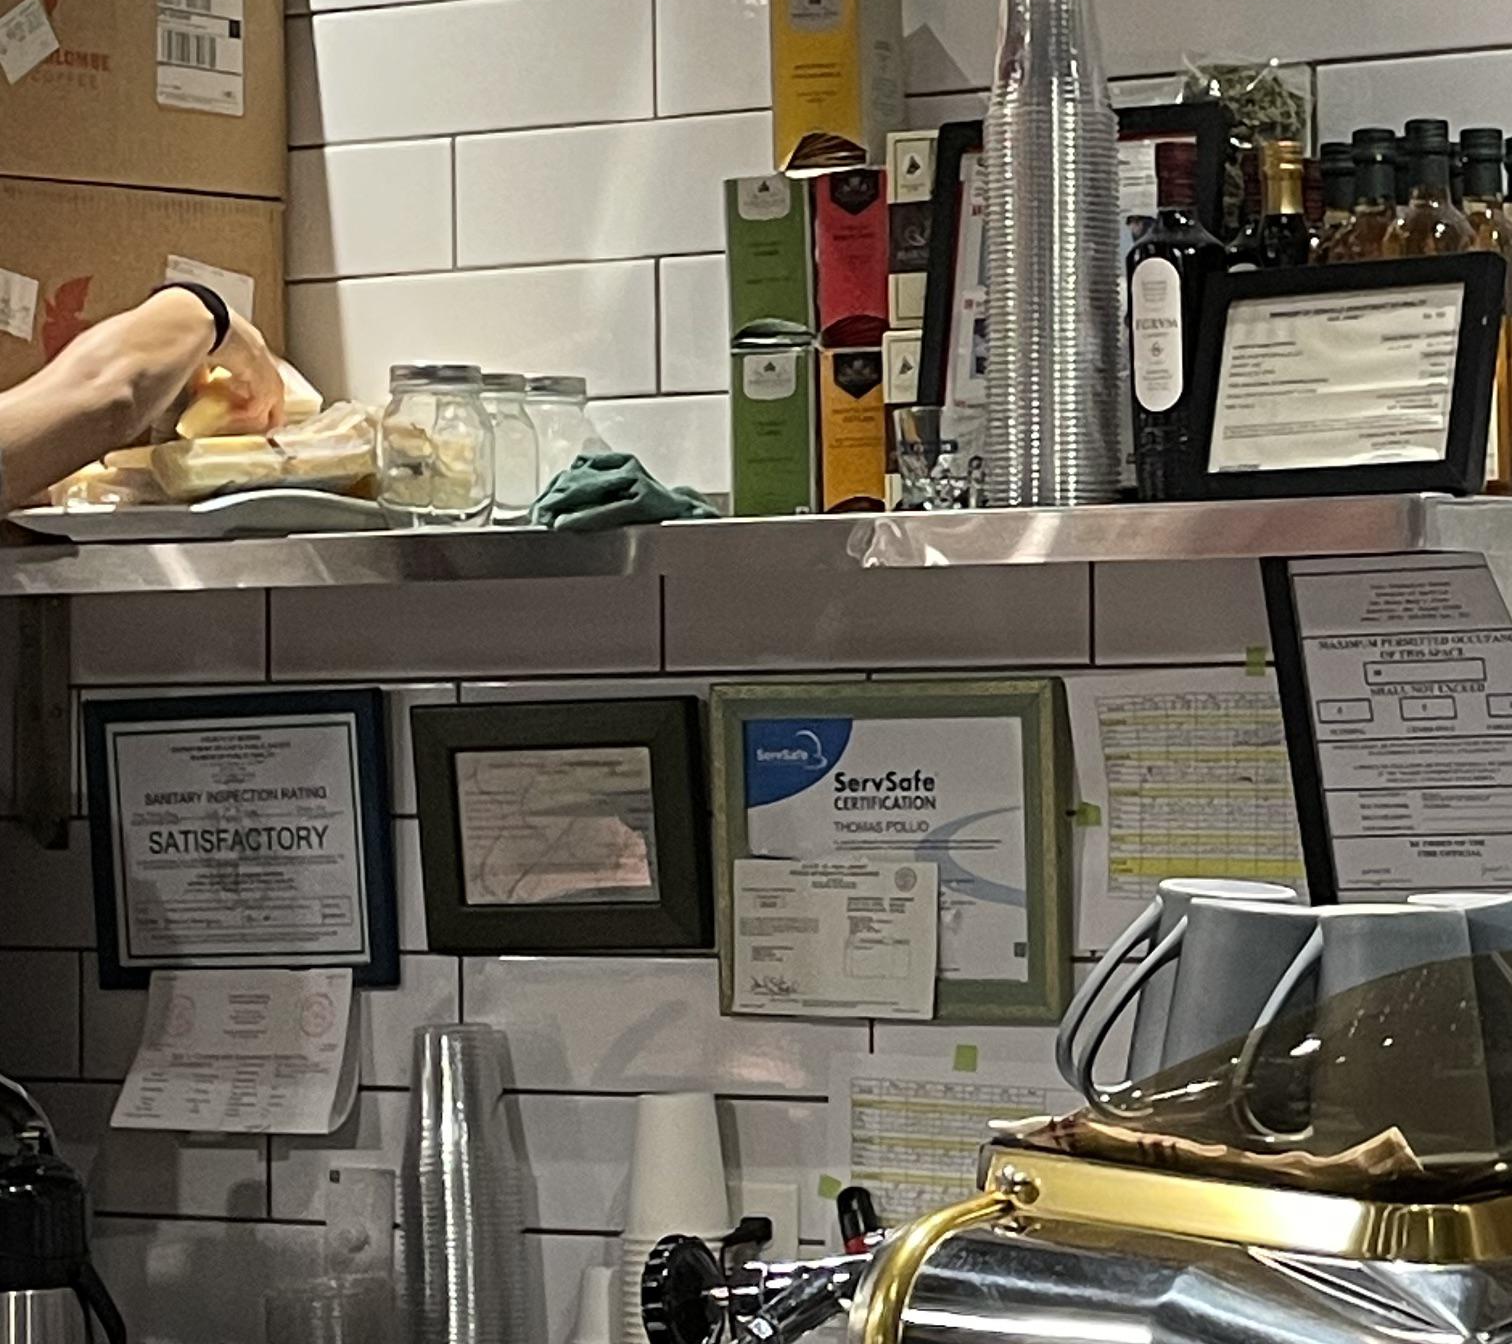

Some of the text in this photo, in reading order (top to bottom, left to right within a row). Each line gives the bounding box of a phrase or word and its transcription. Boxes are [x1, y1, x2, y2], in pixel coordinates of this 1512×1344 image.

[834, 769, 936, 793] ServSafe
[144, 785, 327, 806] SANITARY INSPECTION RATING
[834, 795, 937, 810] CERTIFICATION
[833, 820, 883, 833] THOMAS
[149, 824, 329, 855] SATISFACTORY
